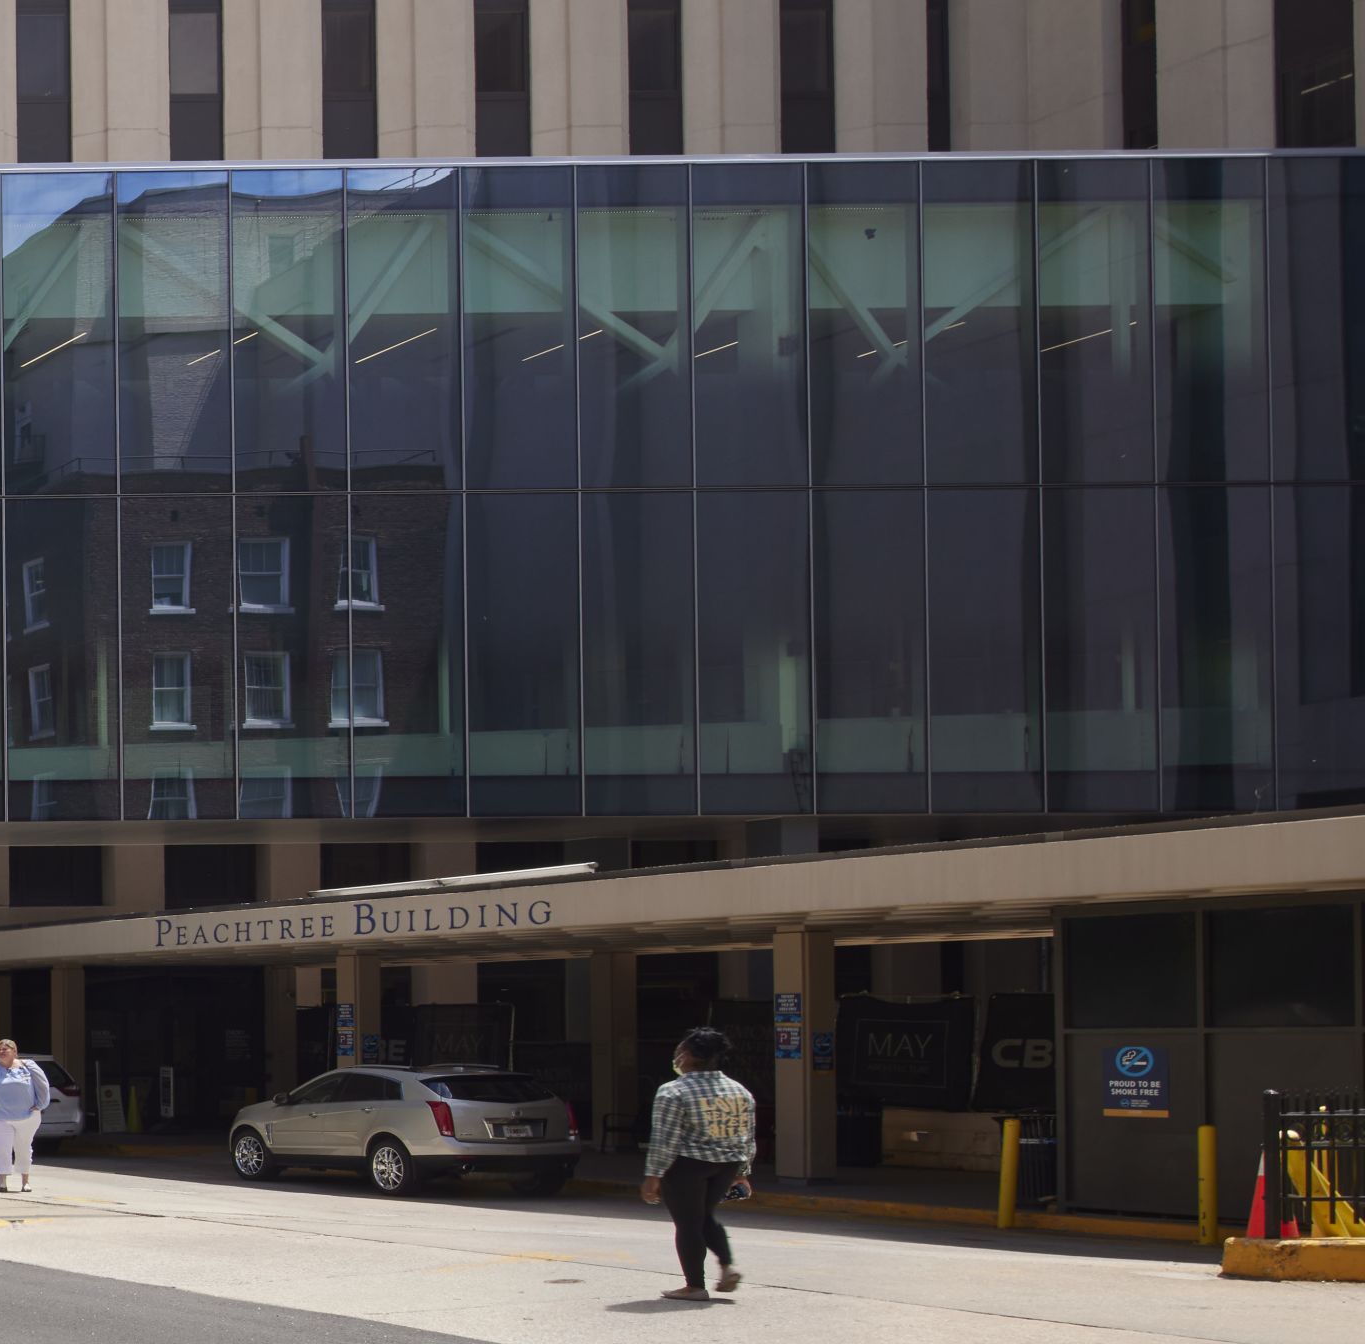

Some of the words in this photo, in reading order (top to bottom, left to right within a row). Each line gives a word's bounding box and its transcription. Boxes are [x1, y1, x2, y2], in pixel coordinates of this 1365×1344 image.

[155, 914, 336, 947] PEACHTREE
[353, 900, 553, 936] BUILDING
[868, 1032, 933, 1059] MAY
[1109, 1080, 1136, 1088] PROUD
[1111, 1088, 1138, 1096] SMOKE
